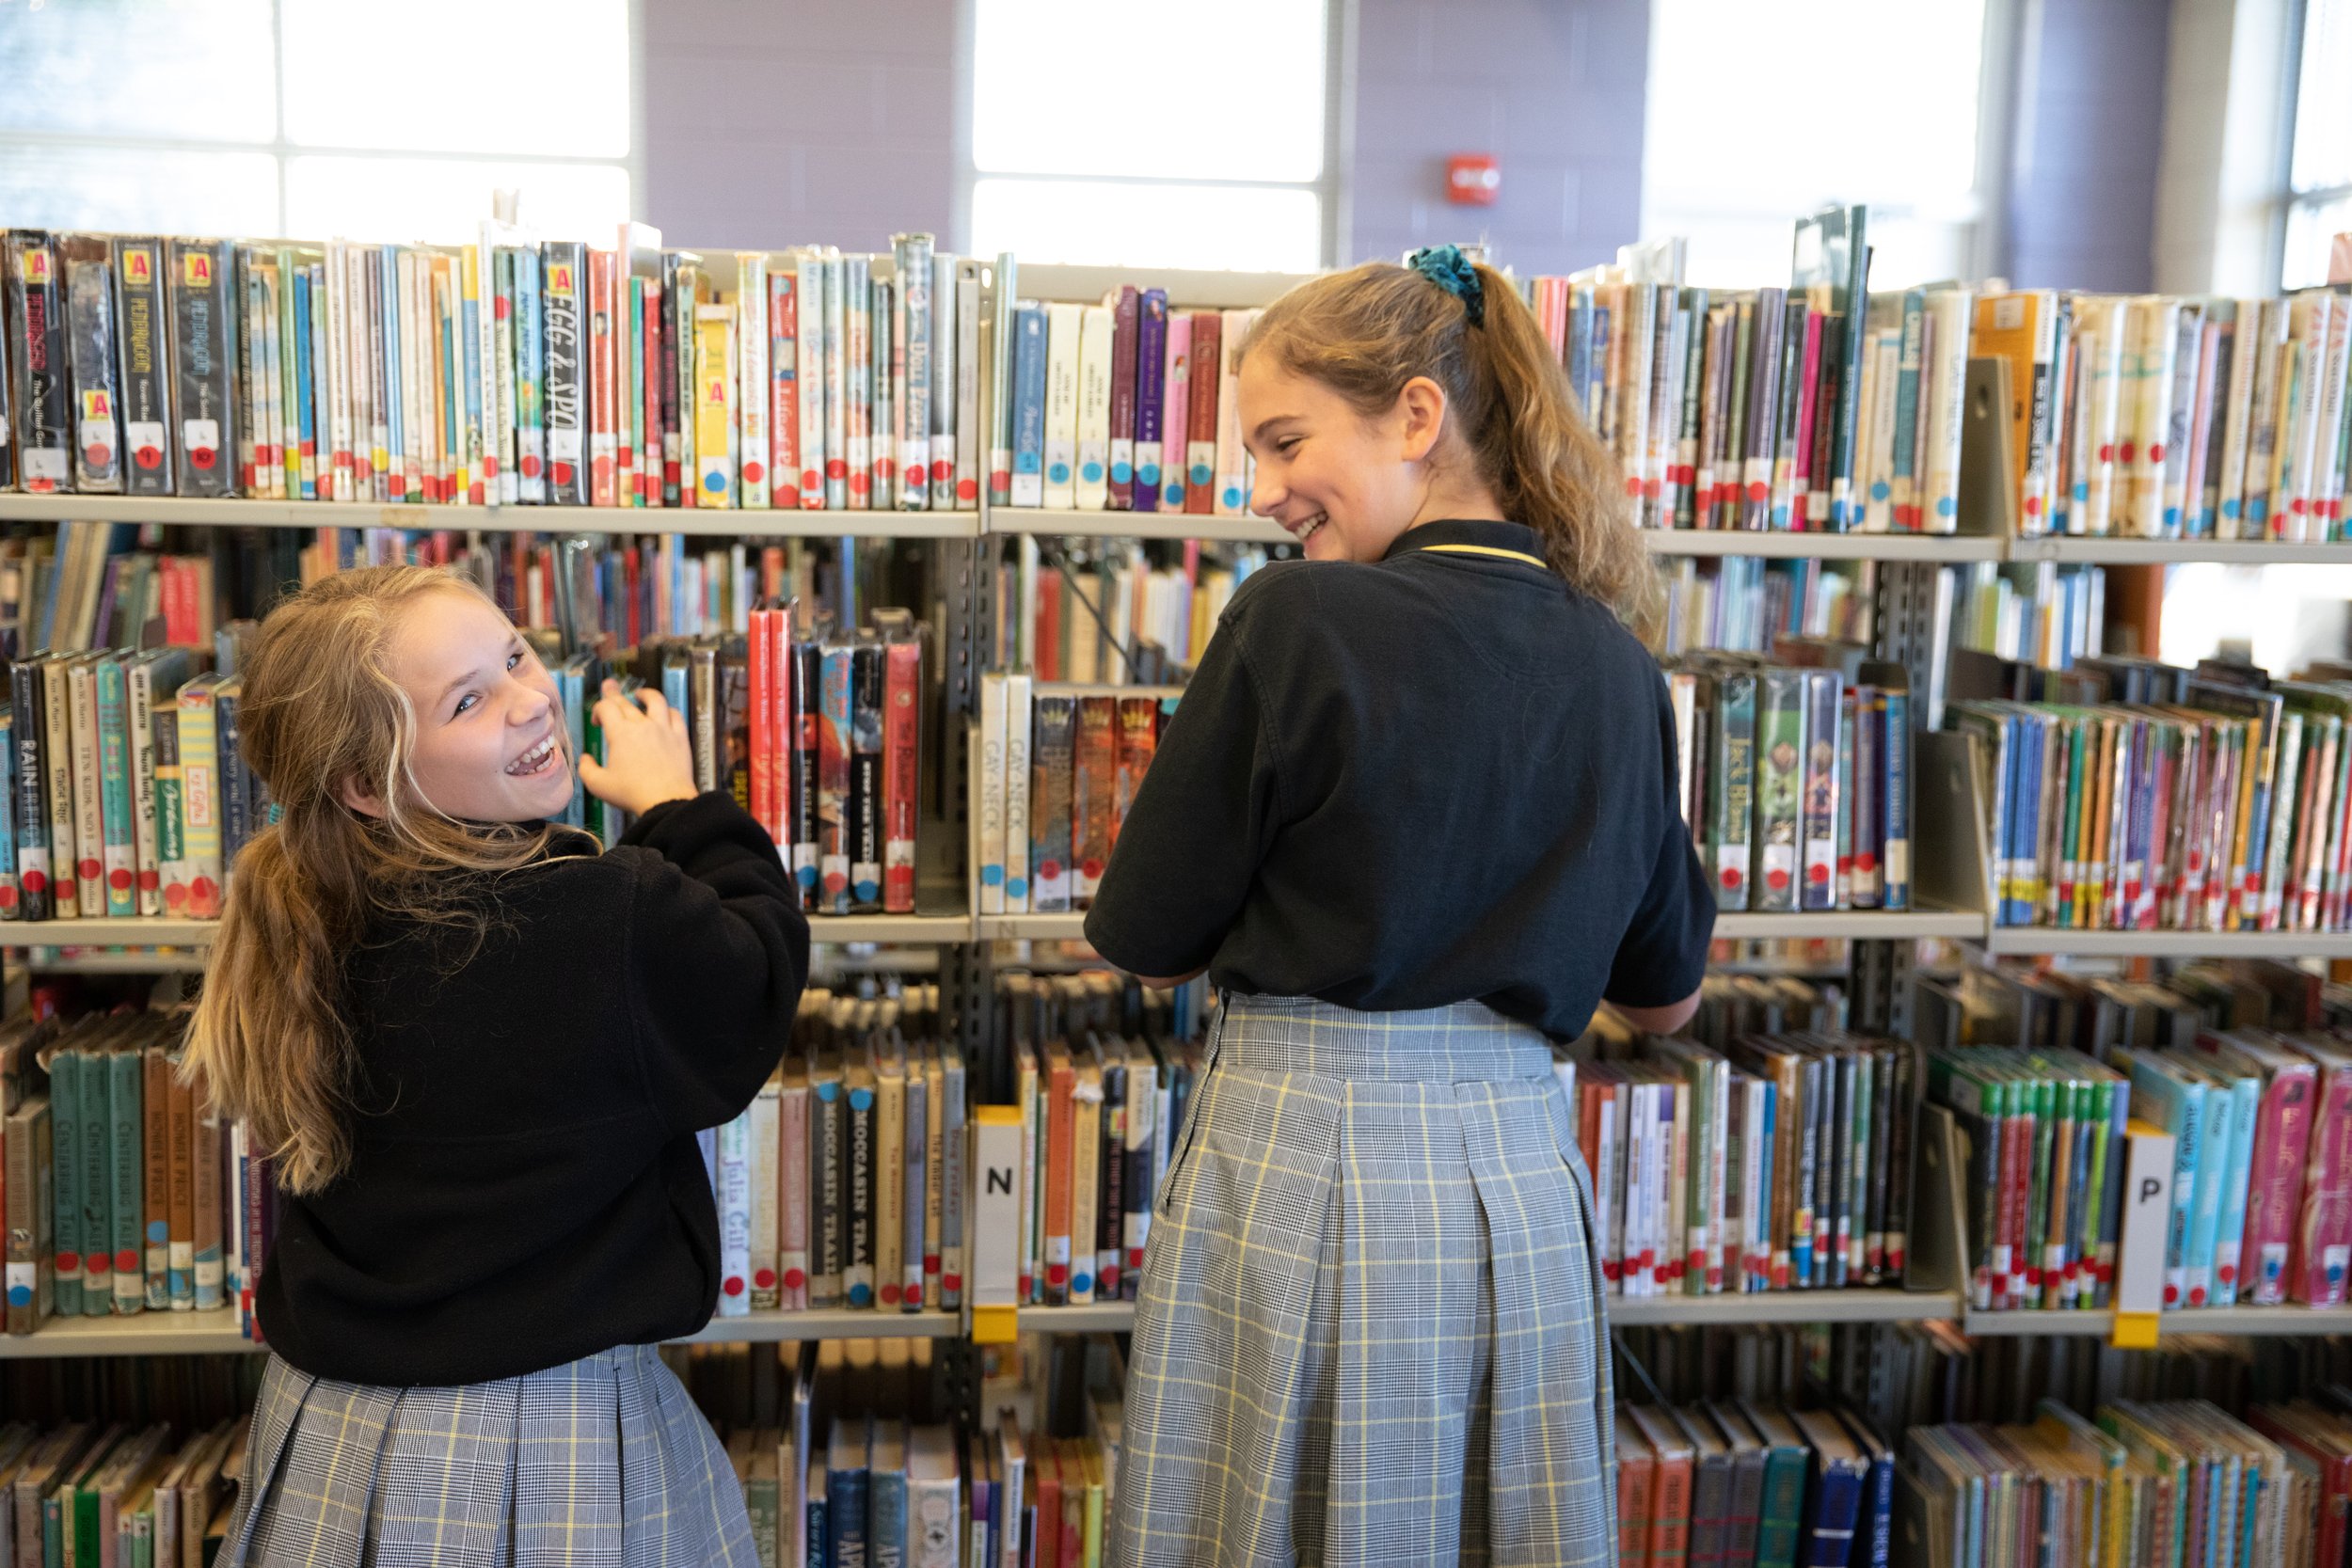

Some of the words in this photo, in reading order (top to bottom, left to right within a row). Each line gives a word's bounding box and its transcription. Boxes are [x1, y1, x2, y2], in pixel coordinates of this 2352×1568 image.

[542, 290, 576, 346] EGG
[544, 352, 576, 371] &
[34, 380, 42, 395] The
[545, 380, 578, 430] SPO
[779, 387, 792, 423] Life
[21, 739, 39, 786] RAIN
[861, 761, 872, 793] STOP
[1724, 733, 1753, 780] Jack
[191, 791, 208, 820] Gifts
[984, 739, 1001, 832] GAY-NECK
[1009, 738, 1025, 830] GAY-NECK
[161, 783, 181, 859] Birdwing
[802, 818, 815, 843] RID
[1727, 784, 1749, 842] Blank
[823, 1102, 838, 1206] MOCCASIN
[852, 1110, 868, 1212] MOCCASIN
[723, 1159, 745, 1204] Julia
[986, 1167, 1012, 1196] N
[2141, 1178, 2161, 1203] P
[119, 1214, 135, 1250] TALE
